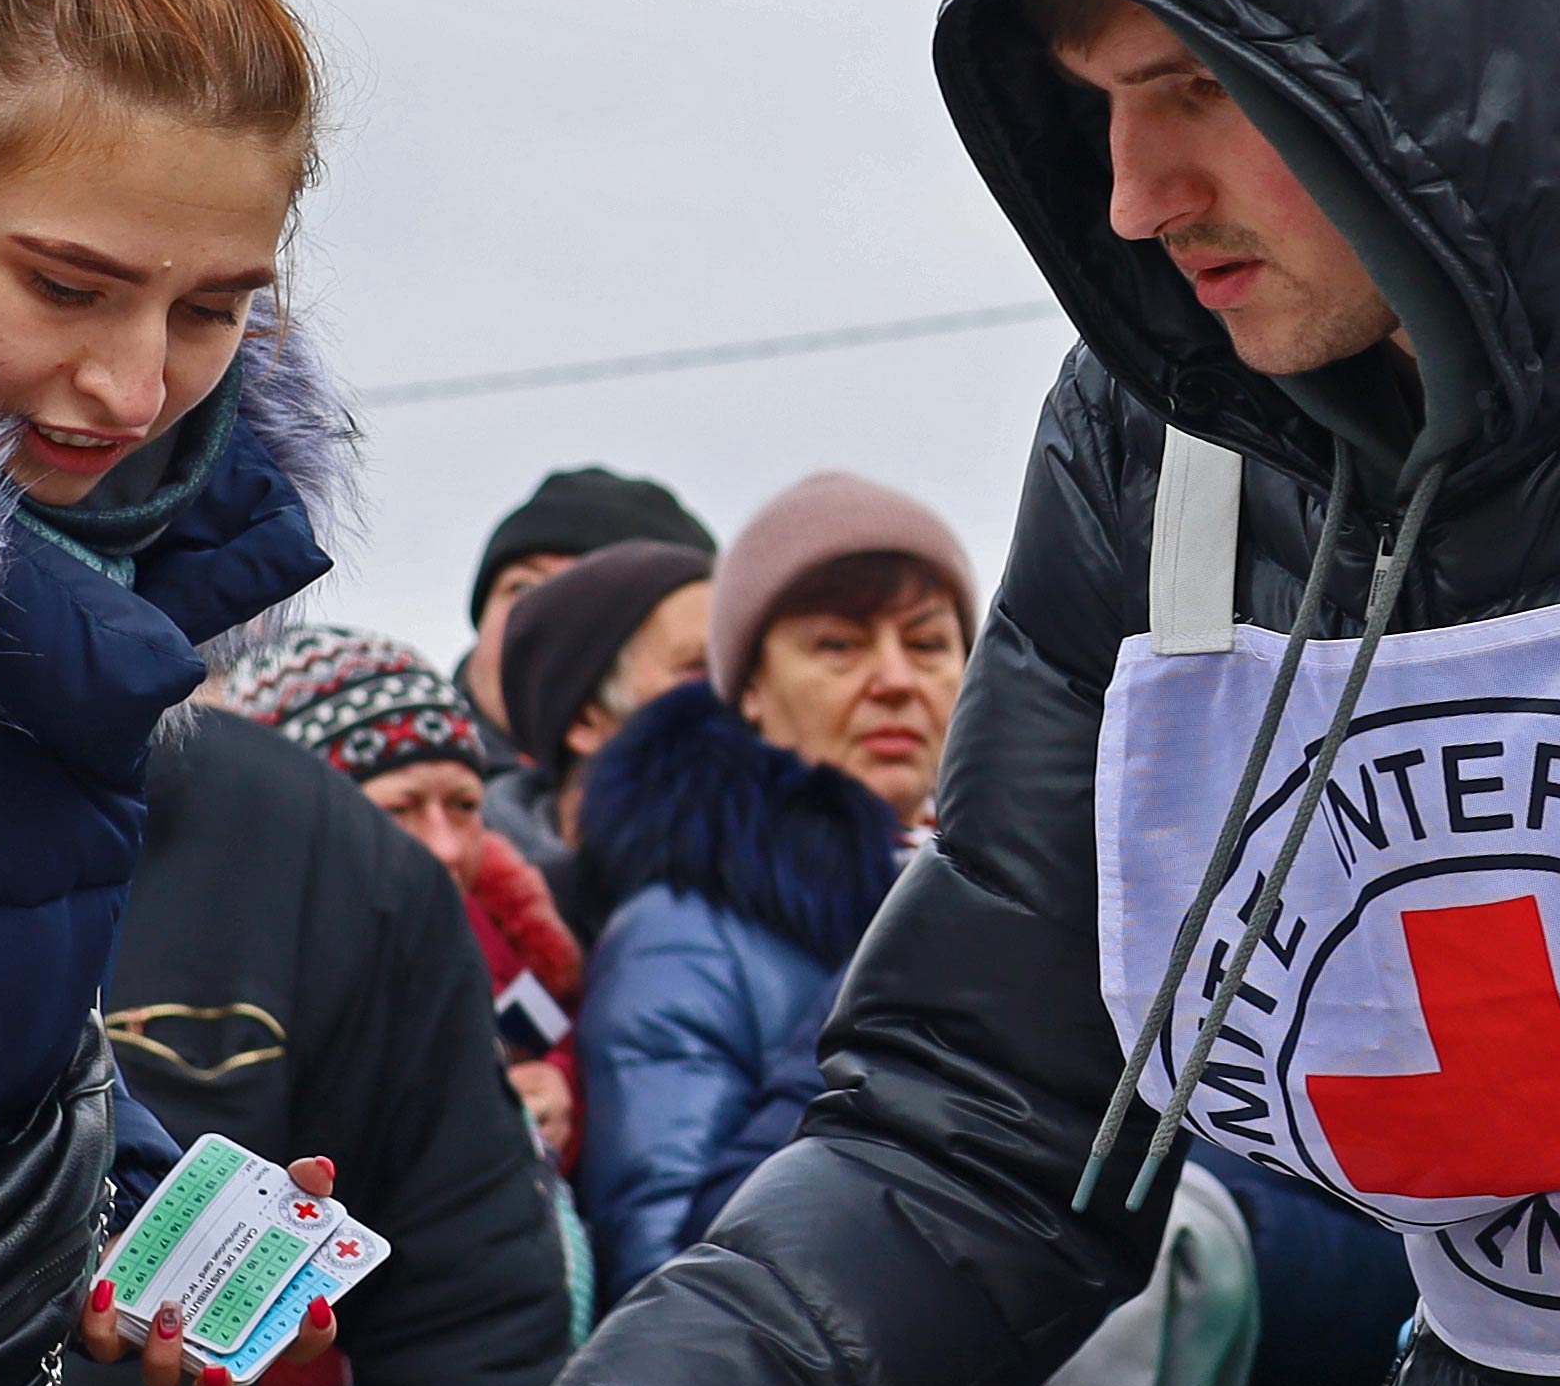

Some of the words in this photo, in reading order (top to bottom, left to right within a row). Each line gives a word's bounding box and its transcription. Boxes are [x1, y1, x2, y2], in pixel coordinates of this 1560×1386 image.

[1198, 869, 1306, 1175] MITE
[233, 1228, 258, 1254] CARTE
[221, 1253, 237, 1269] DE
